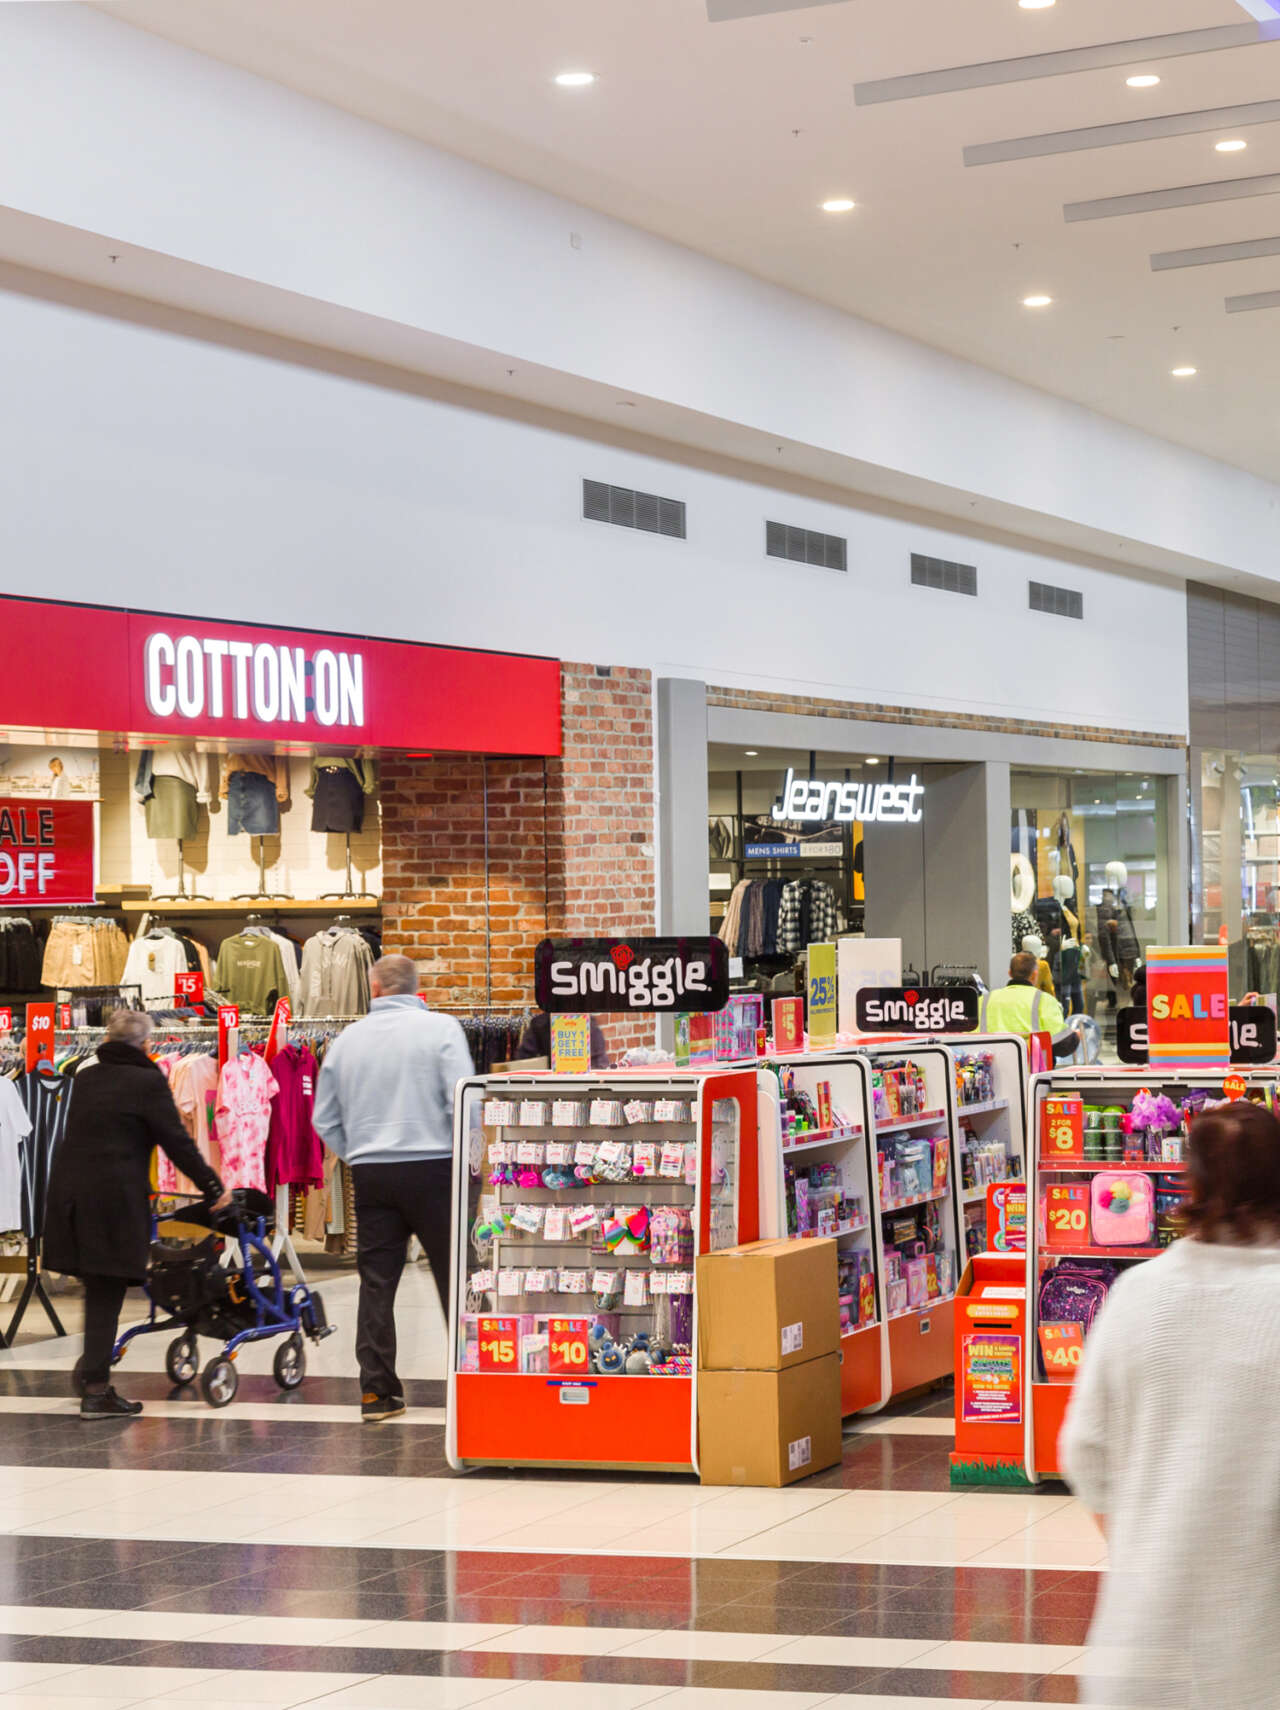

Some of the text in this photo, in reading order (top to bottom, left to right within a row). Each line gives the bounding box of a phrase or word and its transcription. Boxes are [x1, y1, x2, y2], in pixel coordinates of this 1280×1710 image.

[771, 767, 925, 822] Jeanswest
[748, 846, 798, 856] MENS SHIRTS
[0, 851, 56, 894] OFF
[1152, 993, 1226, 1020] SALE
[32, 1015, 50, 1031] $10
[558, 1031, 576, 1039] BUY
[558, 1040, 576, 1048] GET
[559, 1049, 584, 1057] FREE
[1046, 1103, 1077, 1115] SALE
[1049, 1126, 1073, 1150] $8
[1052, 1188, 1083, 1200] SALE
[1049, 1208, 1086, 1231] $20
[482, 1320, 512, 1332] SALE
[553, 1321, 583, 1332] SALE
[1044, 1327, 1076, 1339] SALE
[480, 1340, 515, 1363] $15
[551, 1341, 586, 1364] $10
[967, 1344, 993, 1357] WIN
[1046, 1345, 1083, 1367] $40
